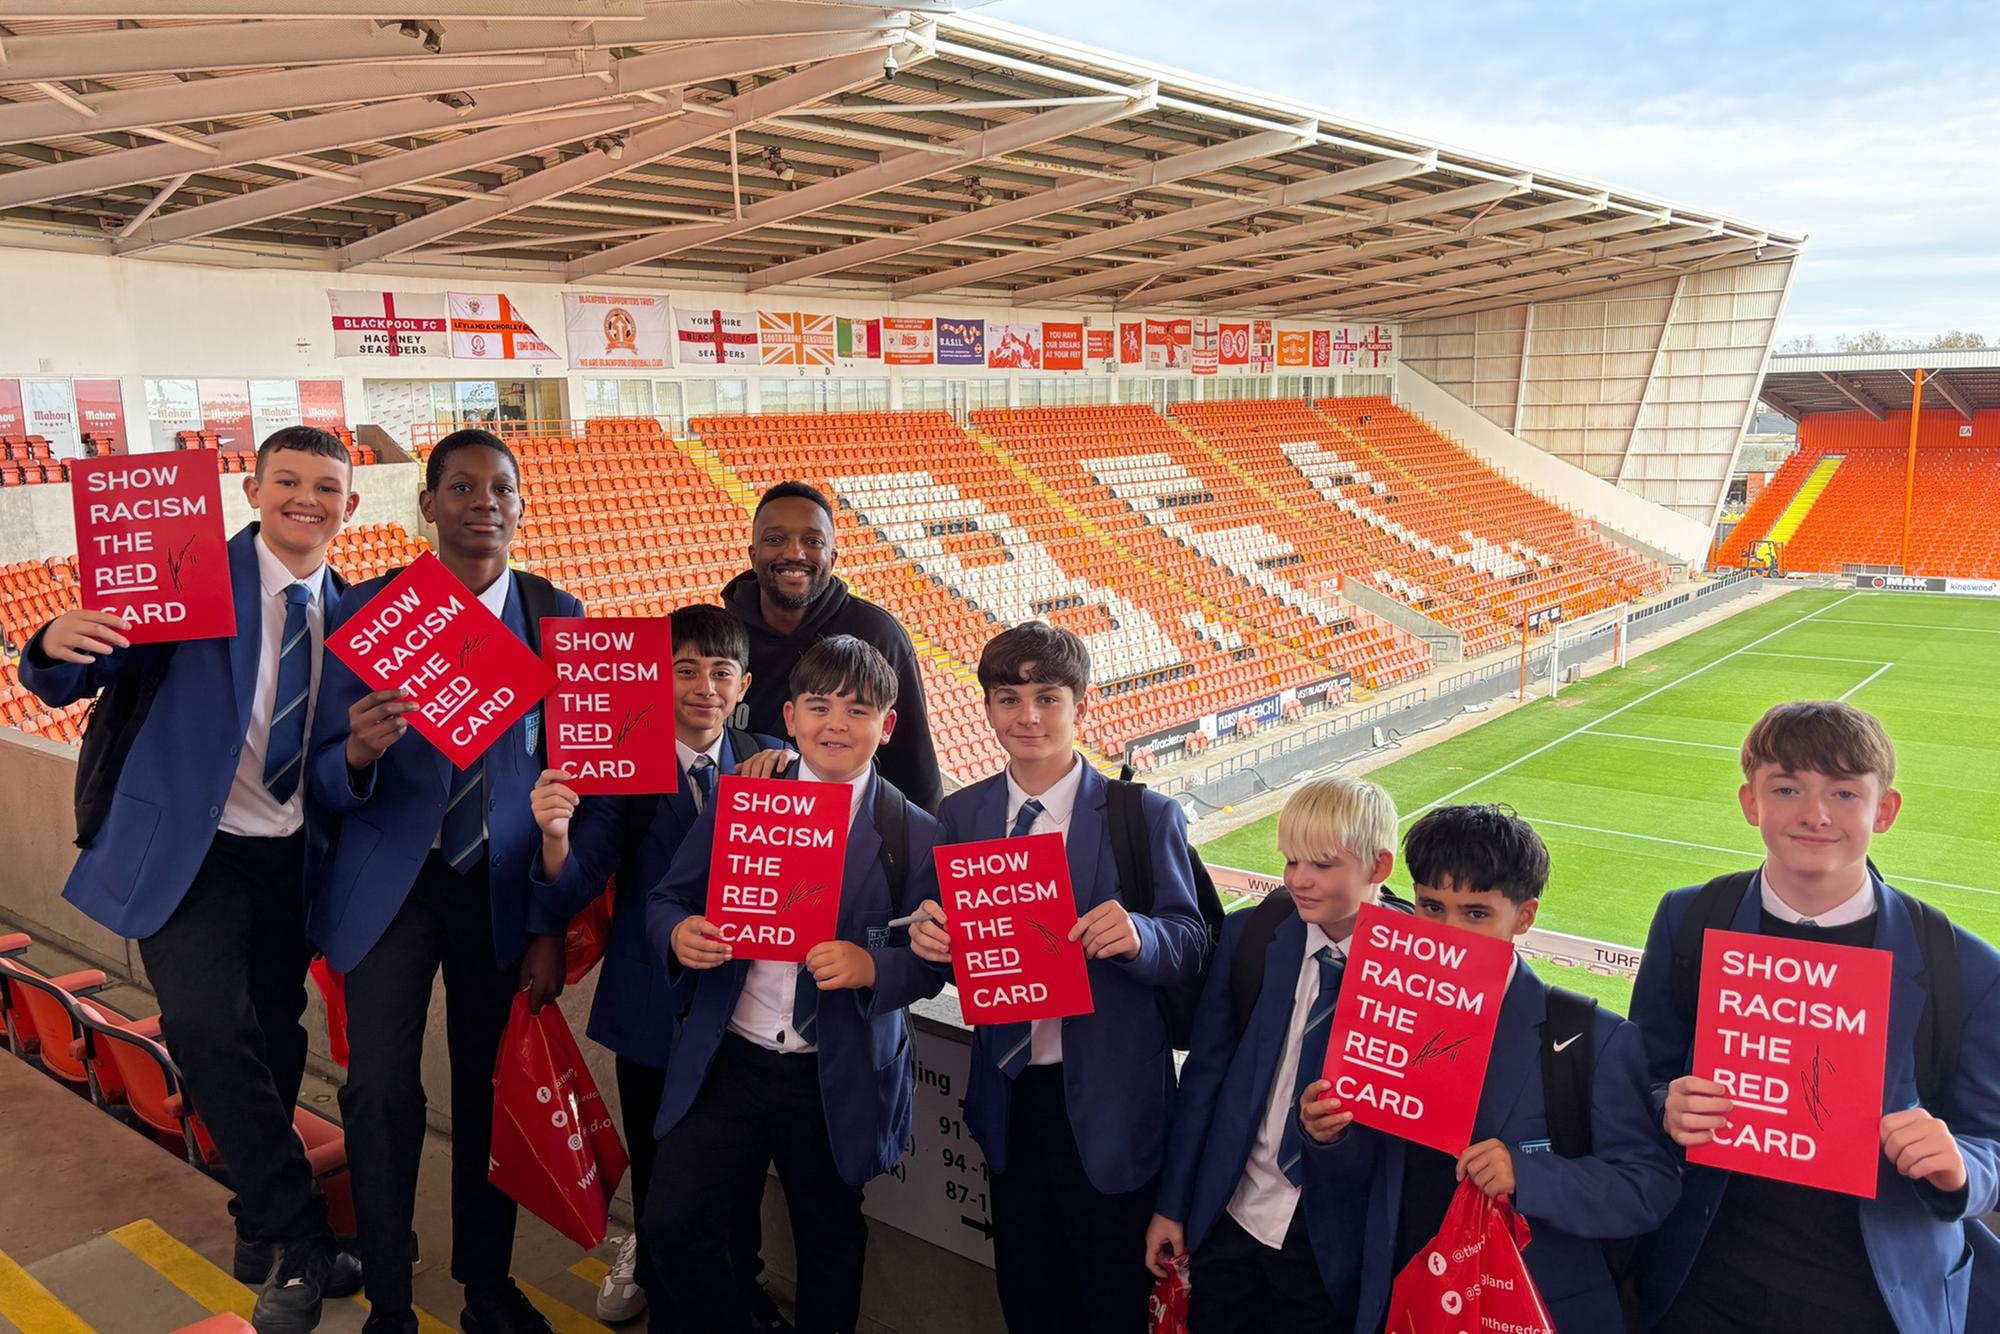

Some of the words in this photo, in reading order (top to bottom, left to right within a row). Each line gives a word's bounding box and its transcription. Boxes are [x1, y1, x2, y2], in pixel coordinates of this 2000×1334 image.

[344, 319, 417, 329] BLACKPOOL
[423, 321, 437, 329] FC
[691, 317, 742, 326] YORKSHIRE
[360, 345, 426, 354] SEASIDERS
[364, 335, 421, 343] HACKNEY
[698, 350, 745, 358] SEASIDERS
[33, 410, 66, 420] Mahou
[85, 410, 116, 420] Mahou
[158, 408, 191, 418] Mahou
[261, 408, 292, 416] Mahou
[88, 465, 178, 492] SHOW
[90, 496, 206, 524] RACISM
[93, 531, 154, 555] THE
[95, 563, 157, 587] RED
[1886, 577, 1927, 586] MAK
[1950, 582, 1993, 591] kingswood
[100, 602, 186, 624] ARD
[350, 586, 421, 656] SHOW
[373, 595, 465, 680] RACISM
[555, 632, 634, 651] SHOW
[399, 652, 451, 698] THE
[557, 663, 658, 682] RACISM
[420, 676, 471, 723] RED
[558, 694, 610, 712] THE
[452, 687, 514, 746] CARD
[560, 724, 612, 742] RED
[561, 760, 636, 778] CARD
[732, 792, 816, 816] SHOW
[729, 823, 834, 848] RACISM
[728, 854, 781, 876] THE
[950, 851, 1029, 878] SHOW
[723, 885, 778, 907] RED
[955, 880, 1058, 910] RACISM
[720, 924, 795, 945] CARD
[960, 917, 1014, 940] THE
[966, 948, 1020, 970] RED
[1369, 925, 1466, 969] SHOW
[1594, 948, 1640, 967] TURF
[1722, 951, 1838, 988] SHOW
[974, 983, 1048, 1007] CARD
[1361, 960, 1484, 1015] RACISM
[1356, 995, 1418, 1034] THE
[1719, 989, 1866, 1035] RACISM
[1344, 1030, 1408, 1068] RED
[1717, 1029, 1792, 1064] THE
[1335, 1076, 1424, 1120] CARD
[1713, 1068, 1788, 1104] RED
[1712, 1121, 1815, 1161] CARD
